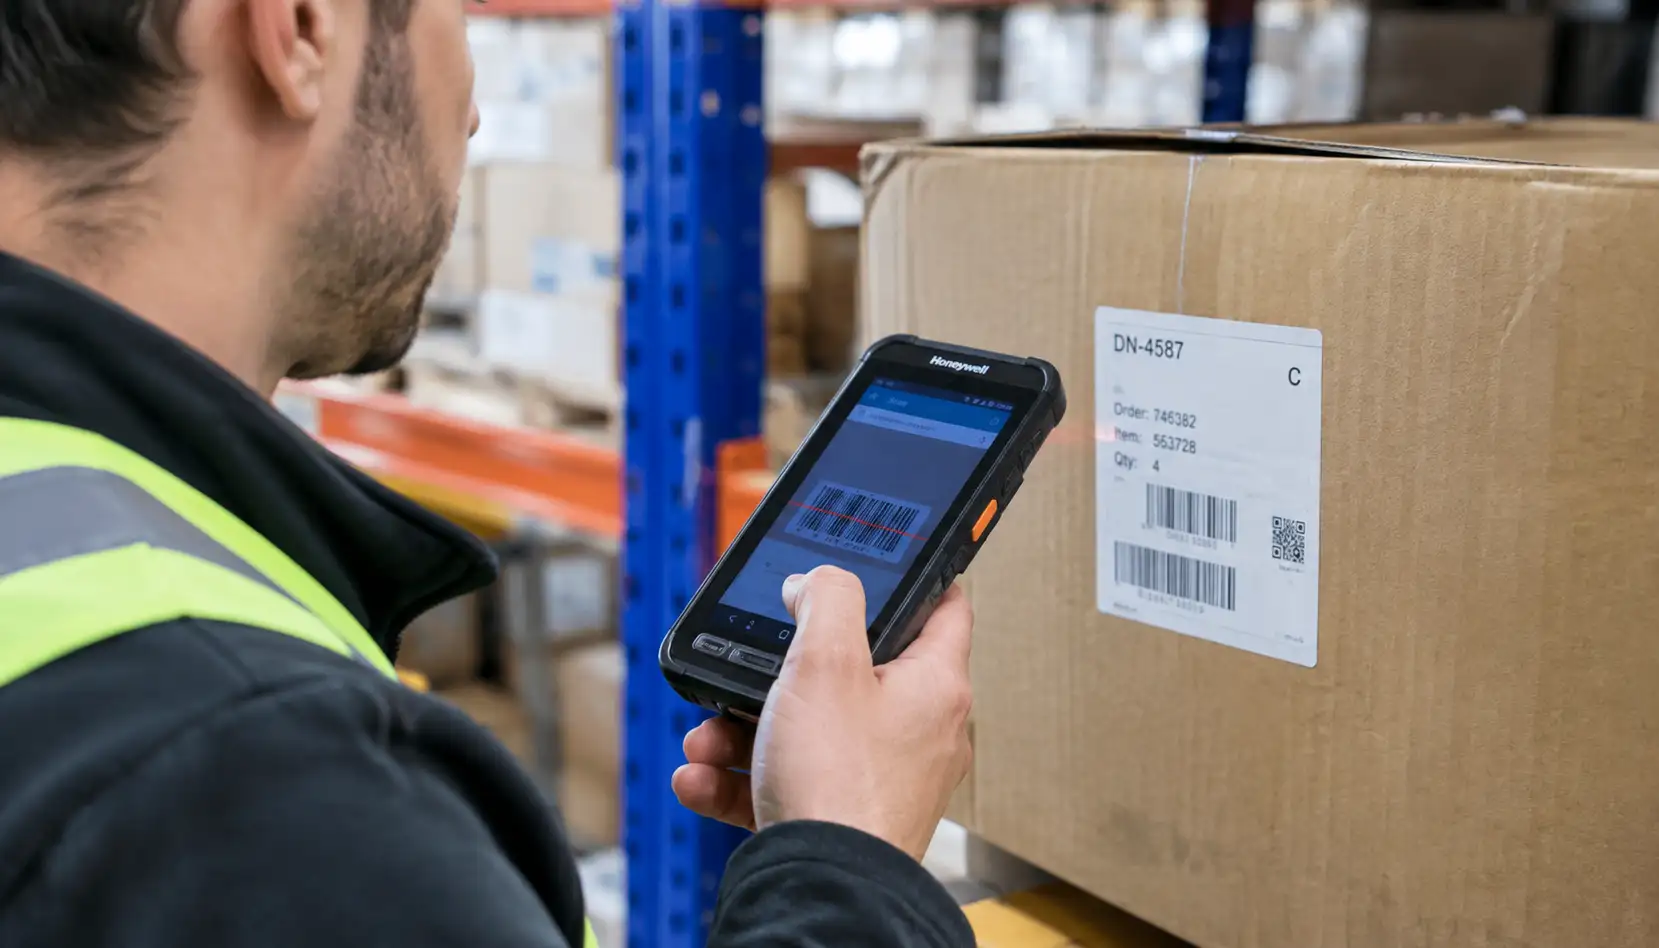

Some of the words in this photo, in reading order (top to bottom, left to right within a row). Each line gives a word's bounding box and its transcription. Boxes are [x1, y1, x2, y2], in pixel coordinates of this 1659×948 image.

[1114, 333, 1184, 360] DN-4587
[930, 355, 990, 375] Honeywell
[1288, 367, 1301, 386] C
[1114, 402, 1149, 420] Order:
[1153, 408, 1197, 429] 746382
[1114, 451, 1137, 470] Qty:
[1152, 459, 1160, 472] 4
